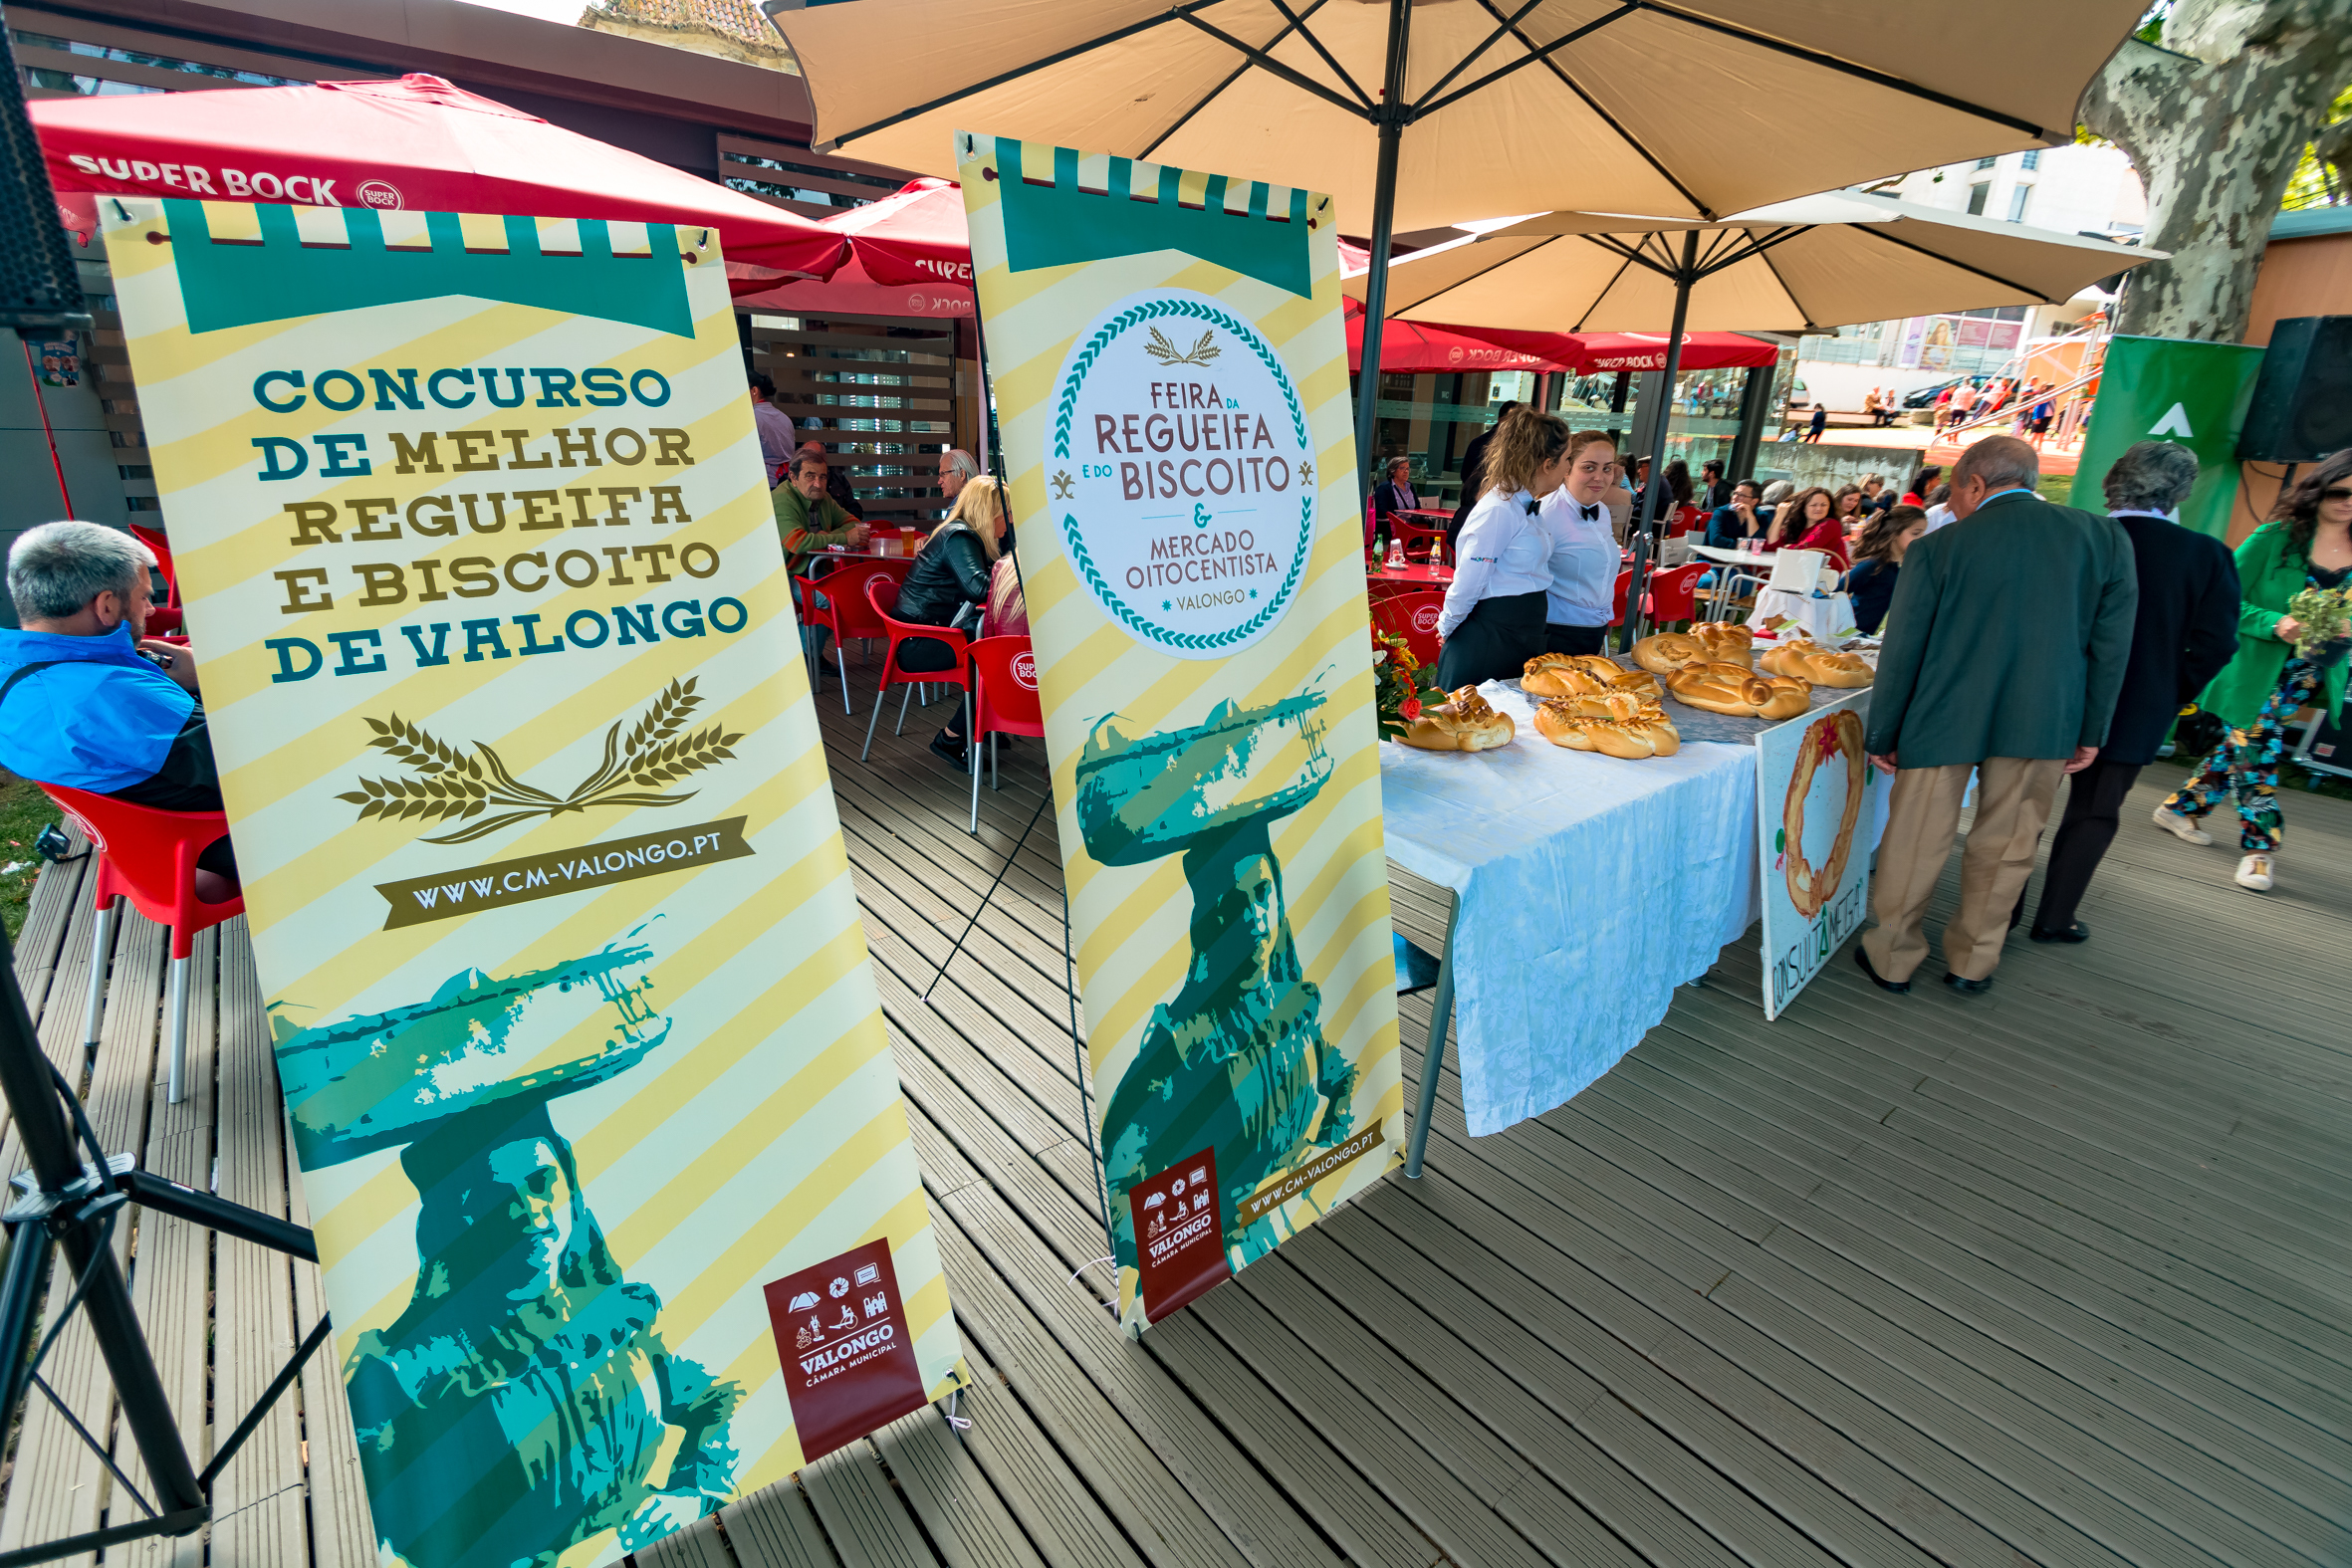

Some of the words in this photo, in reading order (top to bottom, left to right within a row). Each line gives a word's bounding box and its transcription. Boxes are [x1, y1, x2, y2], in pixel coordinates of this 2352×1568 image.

[69, 154, 219, 196] SUPER
[220, 167, 344, 207] BOCK
[364, 189, 395, 201] SUPER
[367, 195, 395, 206] BOCK
[253, 367, 671, 413] CONCURSO
[1150, 381, 1224, 409] FEIRA
[1226, 397, 1240, 409] DA
[251, 433, 372, 482] DE
[387, 427, 695, 475] MELHOR
[1094, 413, 1276, 454] REGUEIFA
[1081, 464, 1090, 479] E
[1093, 464, 1112, 478] DO
[1119, 455, 1291, 501] BISCOITO
[283, 485, 692, 547] REGUEIFA
[1193, 502, 1213, 529] &
[1150, 529, 1255, 560] MERCADO
[274, 566, 334, 614] E
[351, 542, 721, 607] BISCOITO
[1125, 552, 1279, 589] OITOCENTISTA
[1176, 588, 1246, 611] VALONGO
[264, 628, 386, 684] DE
[400, 596, 748, 668] VALONGO
[1017, 662, 1035, 671] SUP
[1019, 669, 1038, 679] BOC
[412, 831, 721, 910] WWW.CM-VALONGO.PT
[1250, 1131, 1373, 1214] WWW.CM-VALONGO.PT
[1148, 1214, 1212, 1258] VALONGO
[1151, 1248, 1179, 1268] CÂMARA
[1180, 1228, 1213, 1250] MUNICIPAL
[800, 1324, 894, 1375] VALONGO
[806, 1365, 846, 1388] CÂMARA
[849, 1341, 897, 1369] MUNICIPAL
